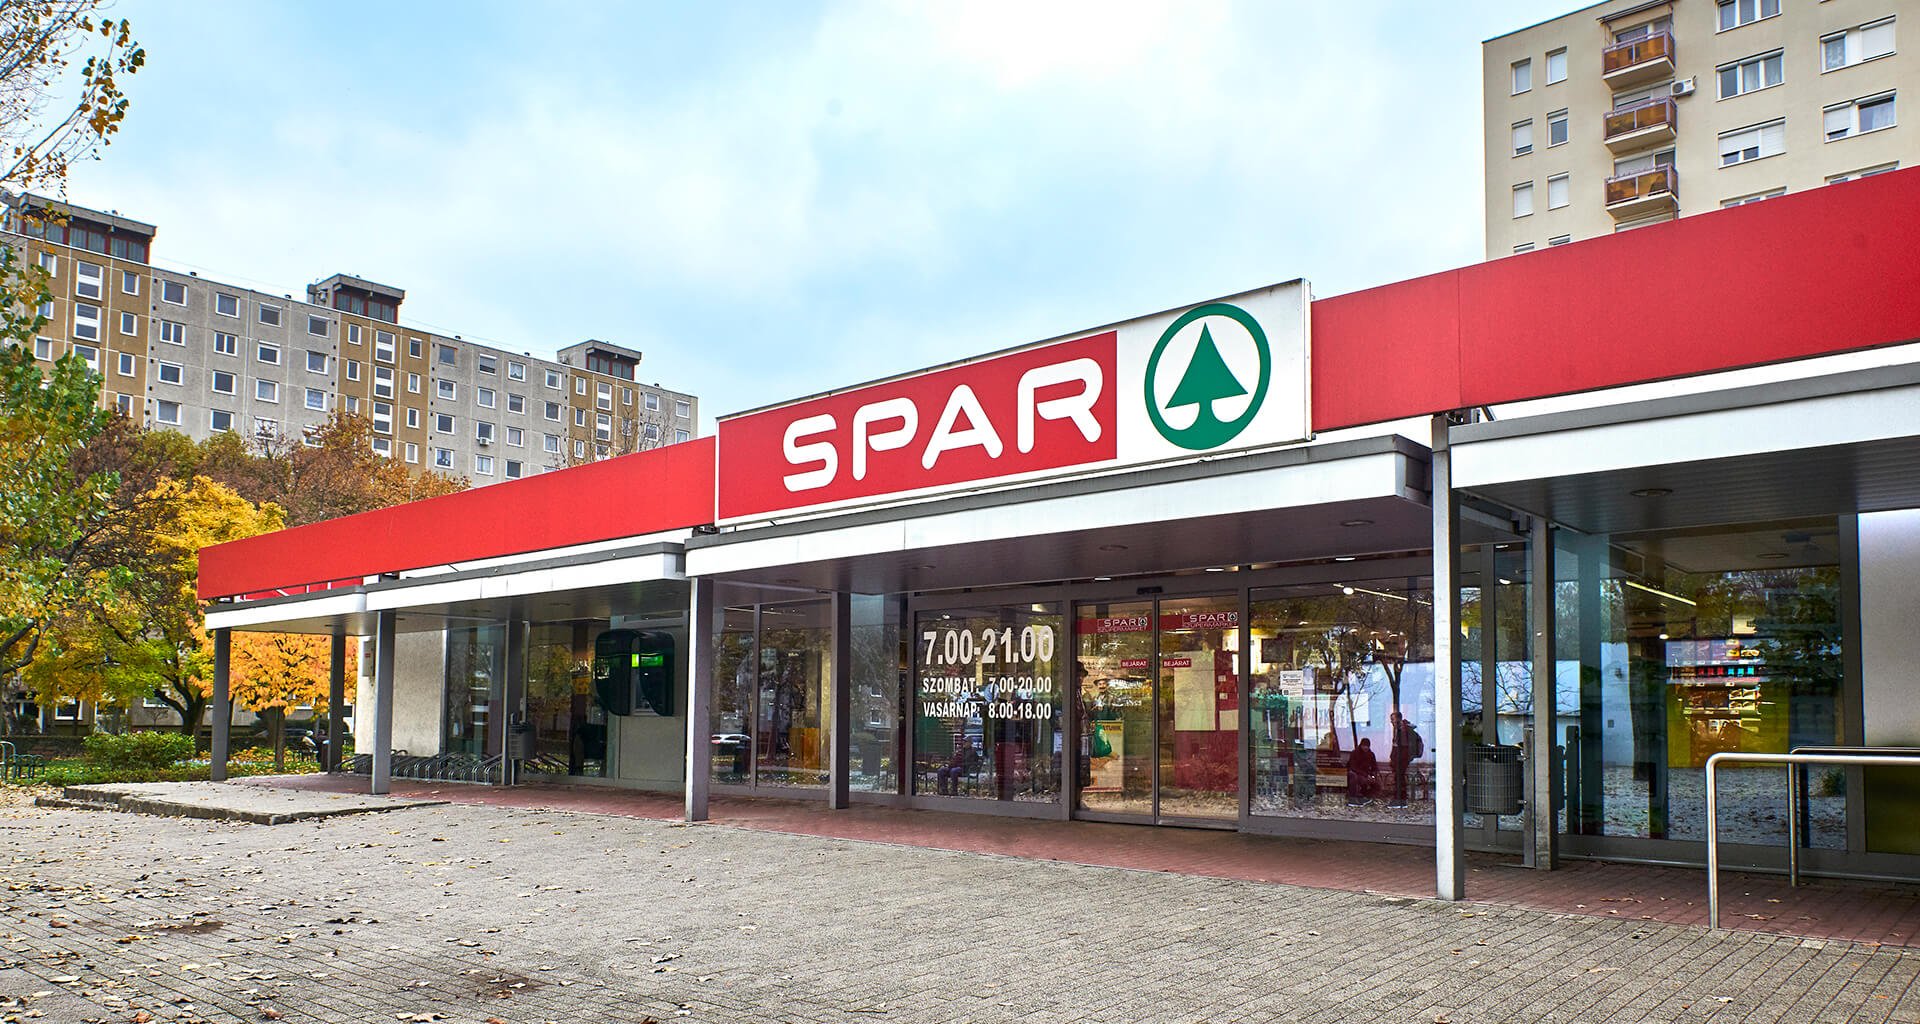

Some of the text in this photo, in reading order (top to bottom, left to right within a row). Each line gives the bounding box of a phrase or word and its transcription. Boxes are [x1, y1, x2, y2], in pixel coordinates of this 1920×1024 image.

[782, 357, 1104, 492] SPAR
[1103, 618, 1137, 628] SPAR
[1189, 613, 1226, 623] SPAR
[923, 625, 1054, 665] 7.00-21.00
[1163, 659, 1190, 667] BEJÁRAT
[923, 698, 1052, 719] VASÁRNAP: 8.00-18.00
